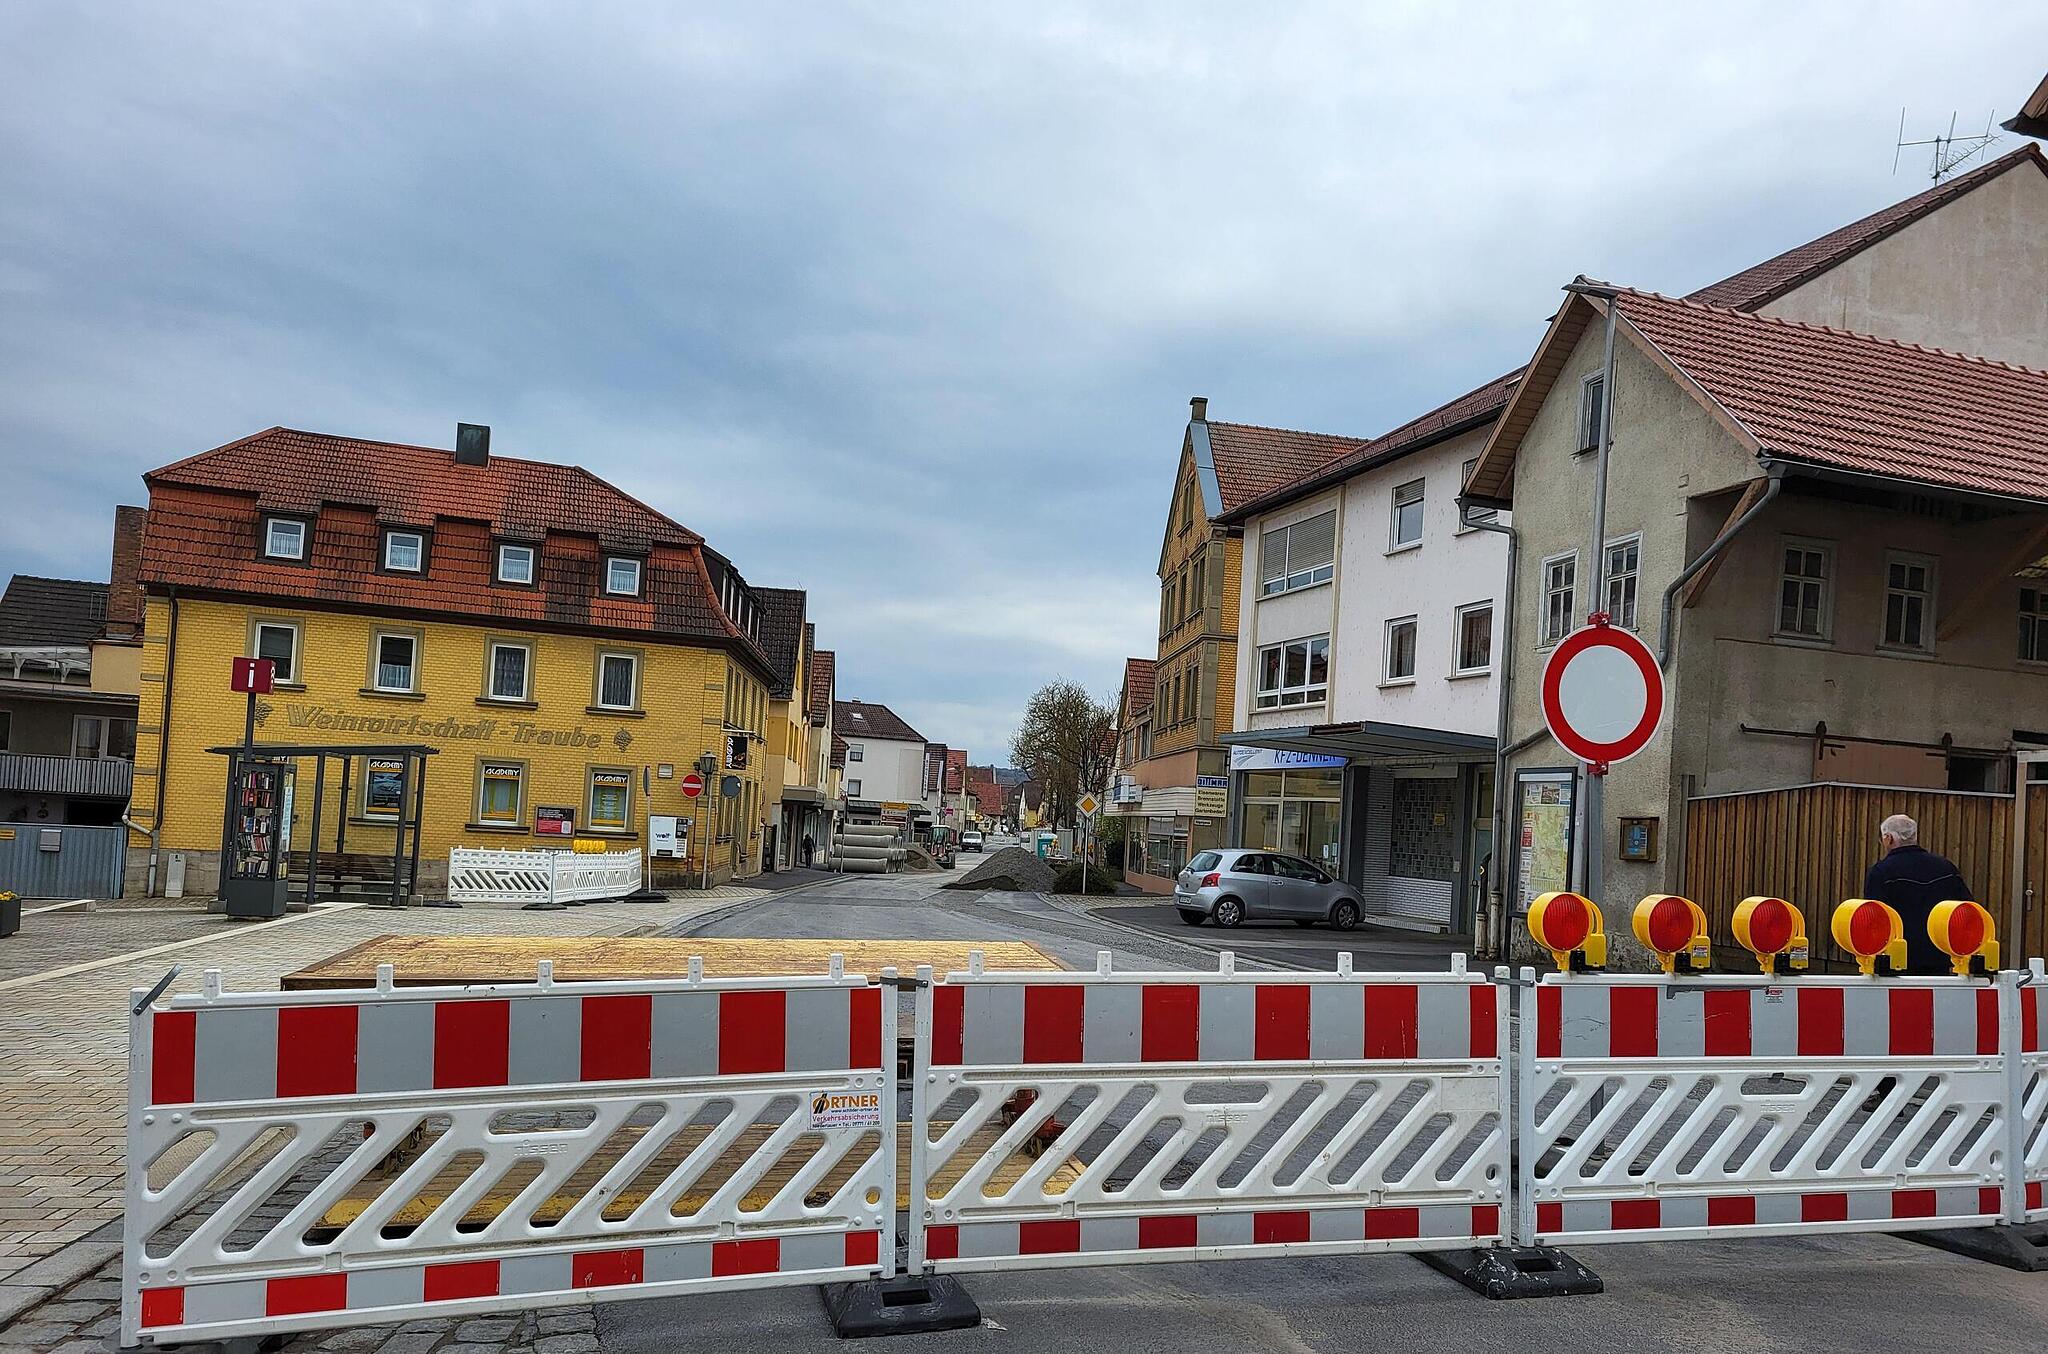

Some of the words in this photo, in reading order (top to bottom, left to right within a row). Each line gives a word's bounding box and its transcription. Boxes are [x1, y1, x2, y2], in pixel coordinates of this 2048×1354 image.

[486, 768, 520, 776] ACADEMY
[594, 775, 627, 784] ACADEMY
[812, 1114, 879, 1122] Verkehrsabsicherung
